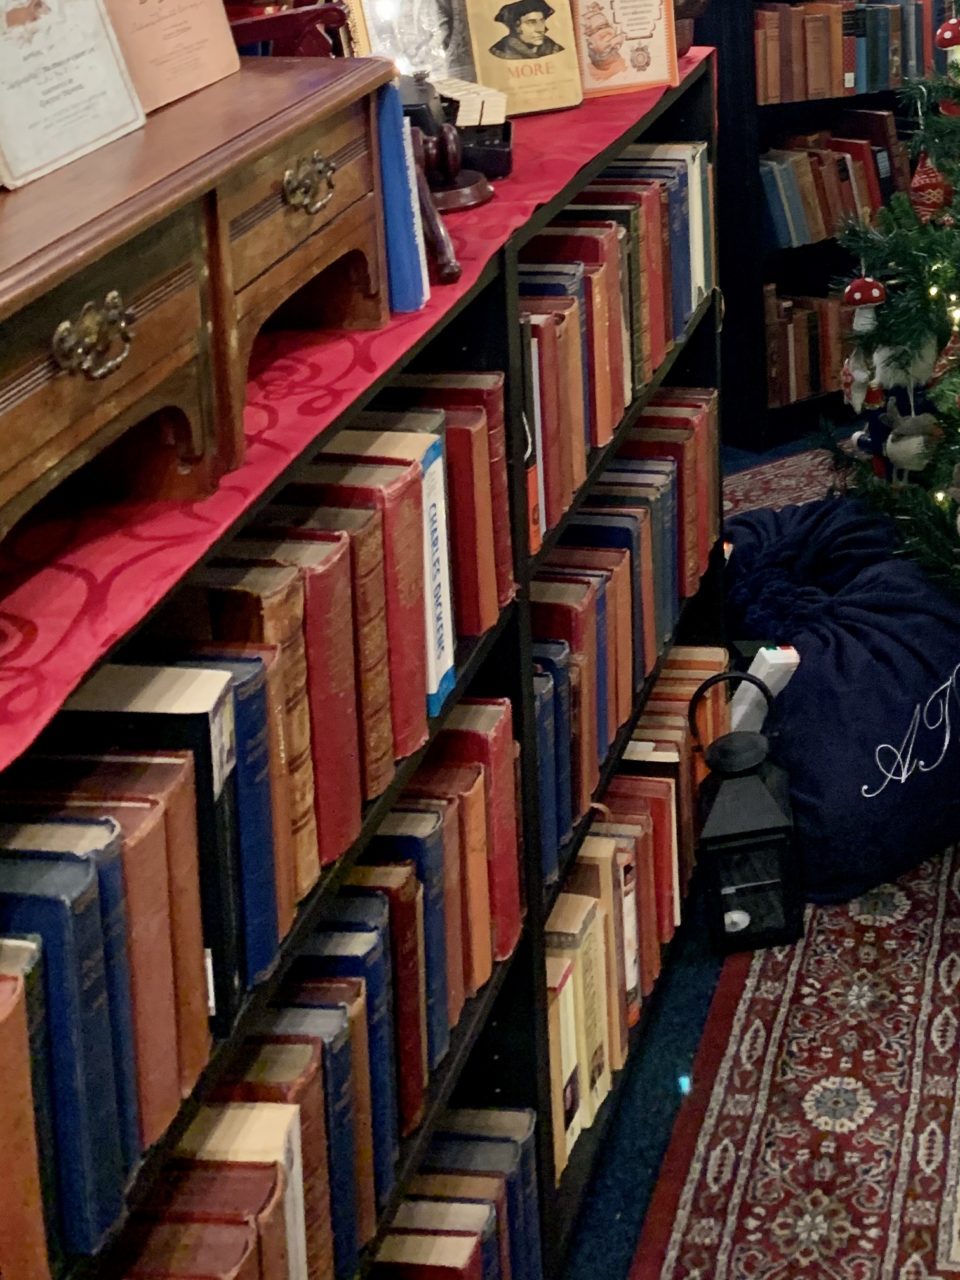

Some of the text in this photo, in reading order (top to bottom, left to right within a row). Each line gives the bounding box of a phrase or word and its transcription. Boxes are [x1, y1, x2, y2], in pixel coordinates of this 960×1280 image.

[507, 61, 555, 79] MORE
[429, 502, 440, 582] CHARLES
[433, 582, 445, 660] DICKENS
